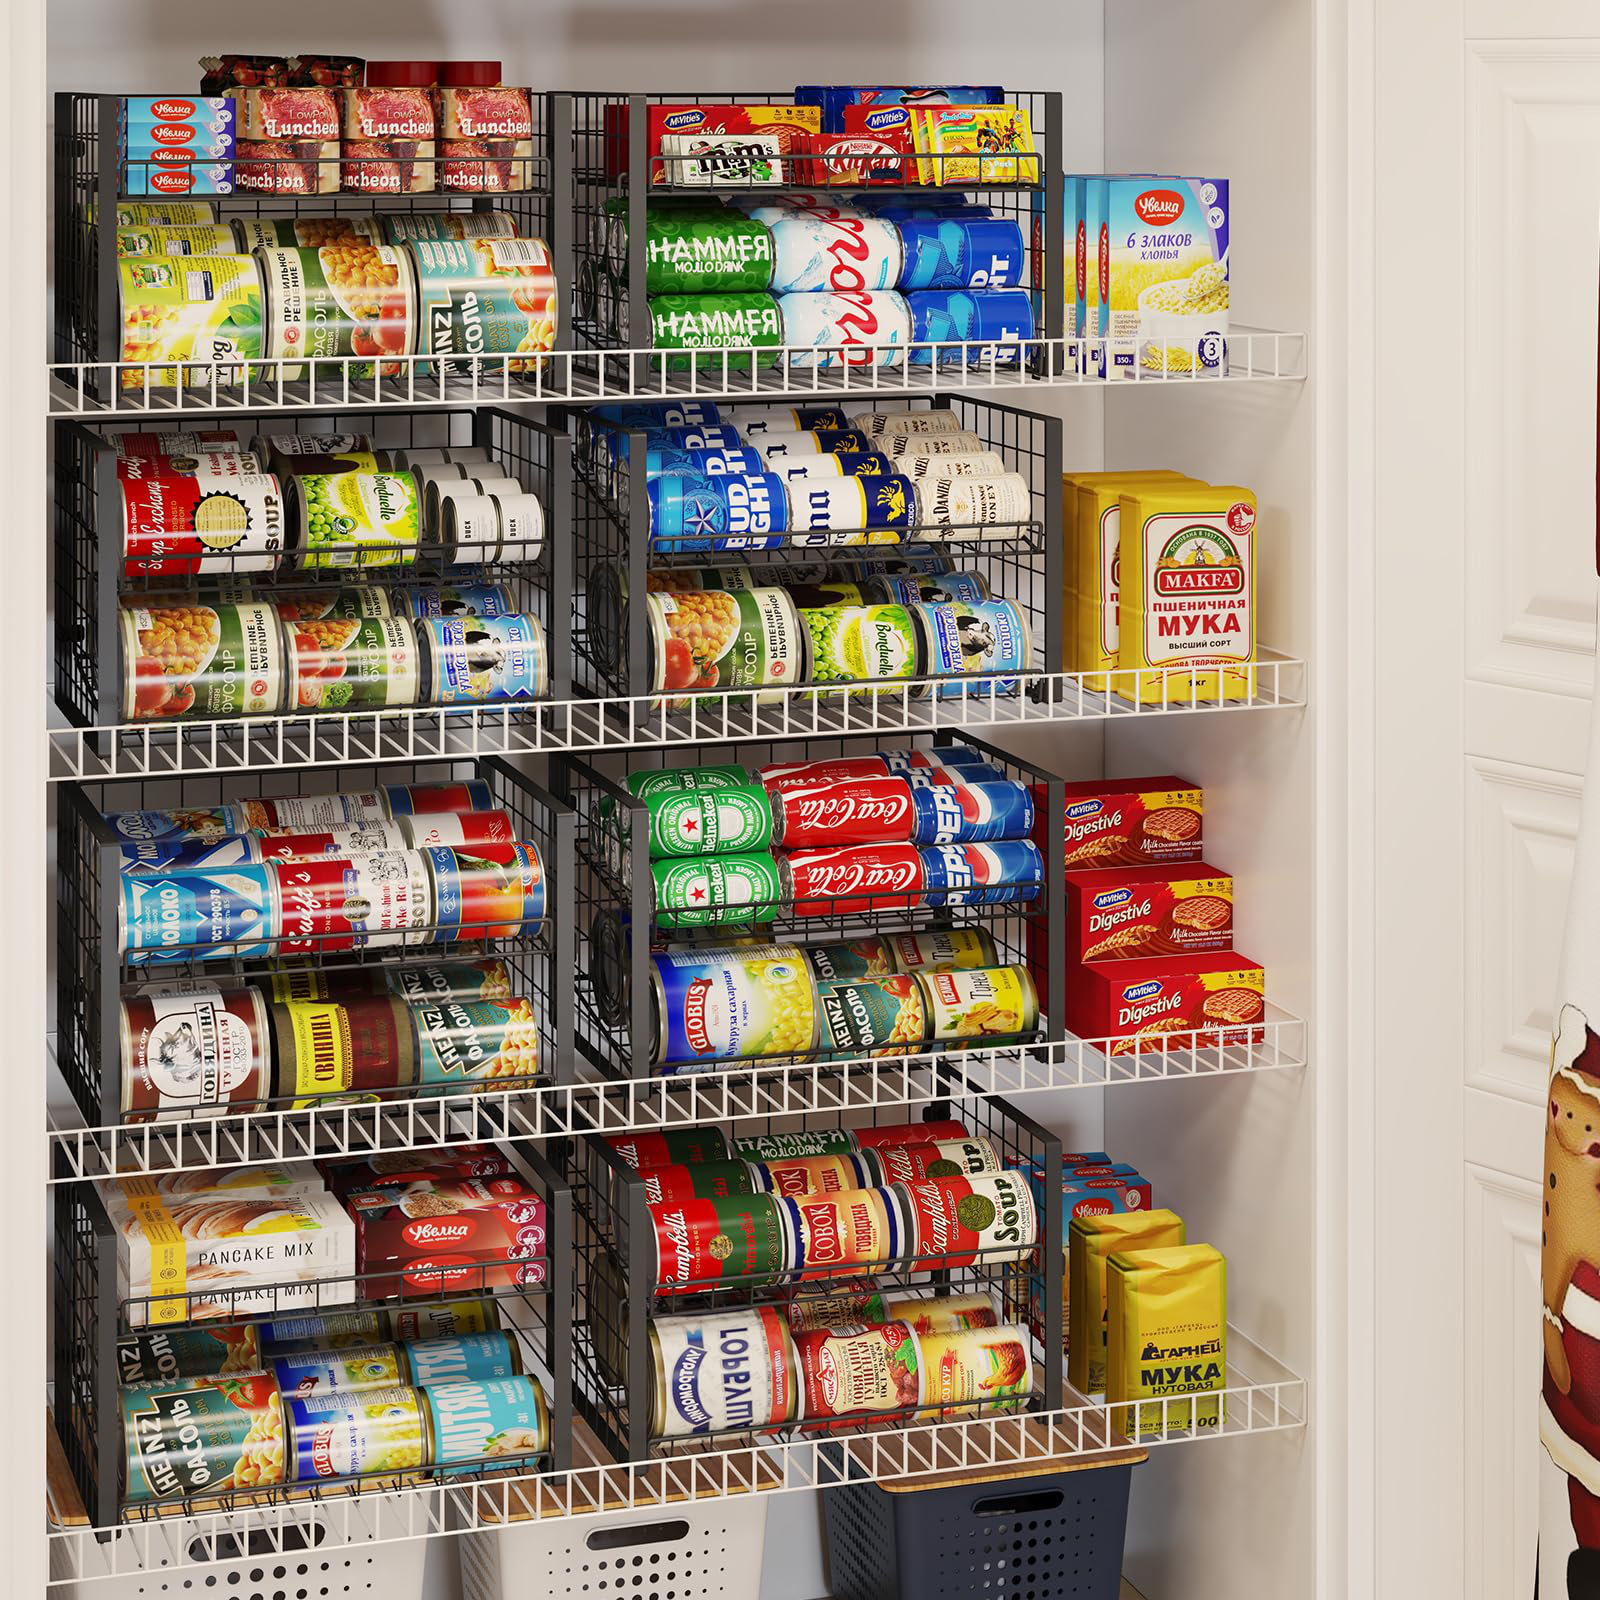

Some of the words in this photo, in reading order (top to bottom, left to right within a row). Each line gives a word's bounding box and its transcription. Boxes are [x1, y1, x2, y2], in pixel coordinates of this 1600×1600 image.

[154, 101, 191, 115] Увелка
[871, 111, 904, 127] McVitie's
[154, 125, 191, 139] Увелка
[154, 173, 190, 187] Увелка
[1139, 197, 1180, 215] Увелка
[1127, 232, 1137, 249] 6
[1140, 233, 1192, 248] злаков
[1140, 249, 1179, 260] хлопья
[277, 251, 292, 323] ПРАВИЛЬНОЕ
[1208, 342, 1217, 357] 3
[139, 481, 171, 536] Exchange
[373, 474, 396, 521] Bonduelle
[725, 482, 751, 549] BUD
[932, 478, 953, 515] DANIEL'S
[264, 494, 280, 551] SOUP
[1165, 572, 1236, 589] MAKFA
[1153, 599, 1246, 612] ПШЕНИЧНАЯ
[1158, 613, 1241, 637] МУКА
[875, 623, 894, 677] Bonduelle
[1168, 639, 1208, 650] ВЫСШИЙ
[1209, 639, 1232, 648] СОРТ
[701, 793, 715, 853] Heineken
[796, 793, 910, 832] Coca-Cola
[928, 784, 962, 845] PEPS
[1064, 809, 1122, 842] Digestive
[1069, 801, 1099, 817] McVitie's
[1140, 838, 1159, 850] Milk
[804, 860, 918, 898] Coca-Cola
[1098, 890, 1128, 907] McVitie's
[287, 870, 322, 947] Swift's
[1088, 898, 1151, 933] Digestive
[1169, 927, 1189, 940] Milk
[722, 969, 738, 1013] сахарная
[935, 974, 959, 1005] ПЕЛИКАН
[1118, 991, 1182, 1026] Digestive
[1128, 983, 1158, 999] McVitie's
[687, 984, 707, 1050] GLOBUS
[723, 1015, 740, 1057] Кукуруза
[826, 998, 854, 1048] HEINZ
[844, 987, 876, 1046] ФАСОЛЬ
[198, 1003, 217, 1101] ГОВЯДИНА
[309, 1013, 335, 1082] СВИНИНА
[426, 1011, 461, 1066] HENZ
[852, 1203, 872, 1254] ГОВЯДИНА
[922, 1180, 951, 1257] Campbell's
[946, 1190, 959, 1241] CONDENSED
[993, 1178, 1020, 1243] SOUP
[408, 1223, 469, 1242] Увелка
[664, 1208, 695, 1290] Campbell's
[692, 1224, 701, 1275] CONDENSED
[813, 1205, 834, 1260] СОВОК
[199, 1246, 275, 1266] PANCAKE
[284, 1242, 314, 1258] MIX
[806, 1344, 814, 1372] БЕЛАРУСЬ
[849, 1340, 865, 1406] ГОВЯДИНА
[858, 1340, 875, 1404] ТУШЕНАЯ
[941, 1365, 951, 1386] КУР
[1140, 1362, 1222, 1387] МУКА
[809, 1373, 818, 1412] РЕСПУБЛИКА
[879, 1377, 888, 1398] ГОСТ
[1152, 1380, 1214, 1395] НУТОВАЯ
[141, 1417, 180, 1492] HENZ
[170, 1398, 211, 1485] ФАСОЛЬ
[314, 1427, 332, 1477] GLOBUS
